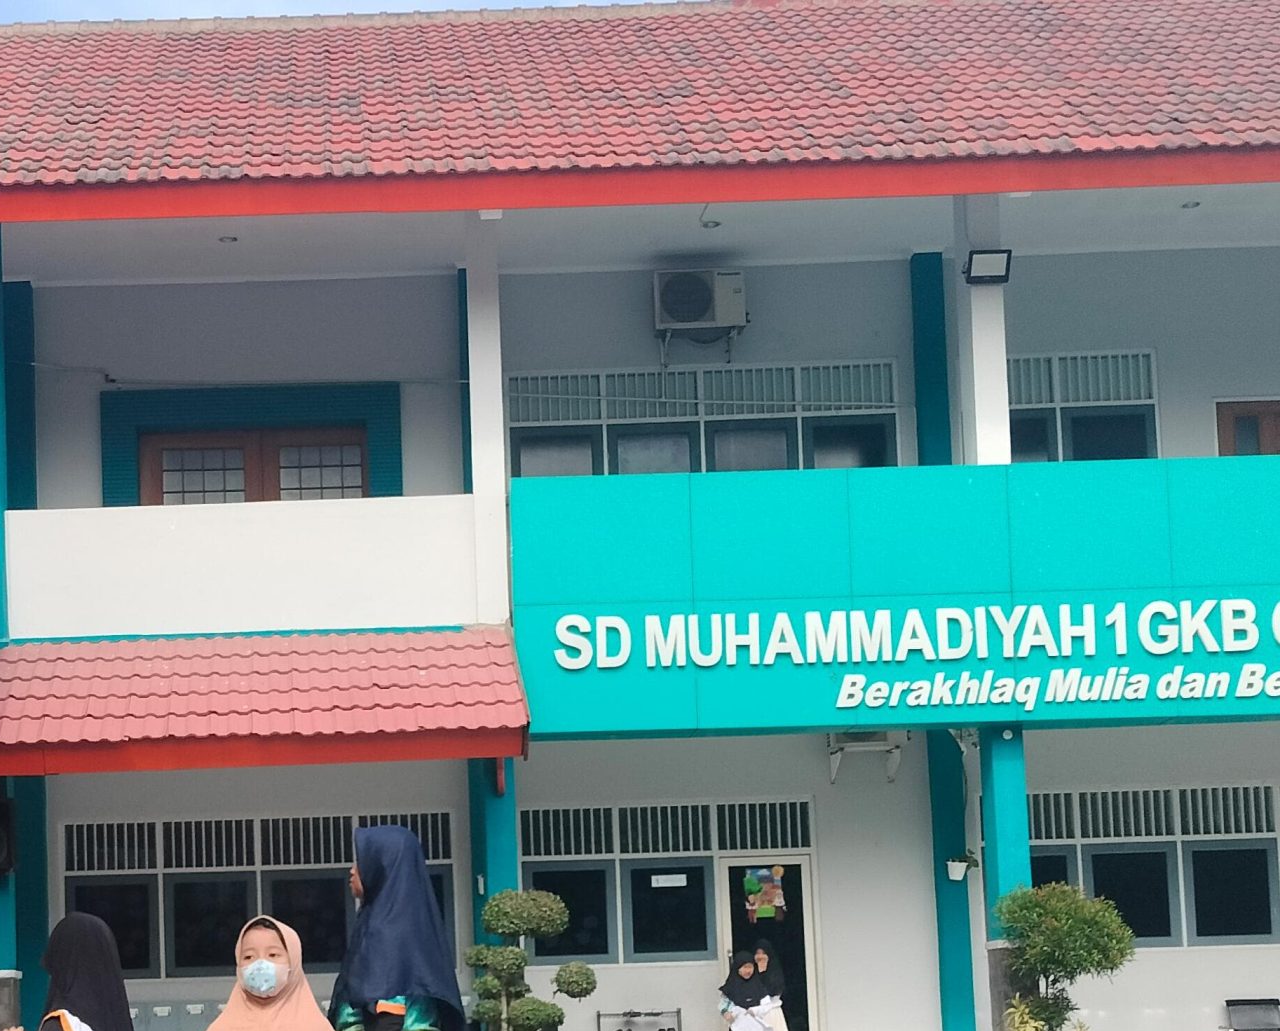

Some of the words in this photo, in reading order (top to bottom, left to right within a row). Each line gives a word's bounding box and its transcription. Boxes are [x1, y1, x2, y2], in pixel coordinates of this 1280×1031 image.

[554, 614, 631, 670] SD
[645, 602, 1097, 667] MUHAMMADIYAH
[1105, 602, 1127, 656] 1
[1138, 599, 1260, 655] GKB
[836, 668, 1042, 711] Berakhlaq
[1044, 667, 1151, 704] Mulia
[1156, 665, 1231, 700] dan
